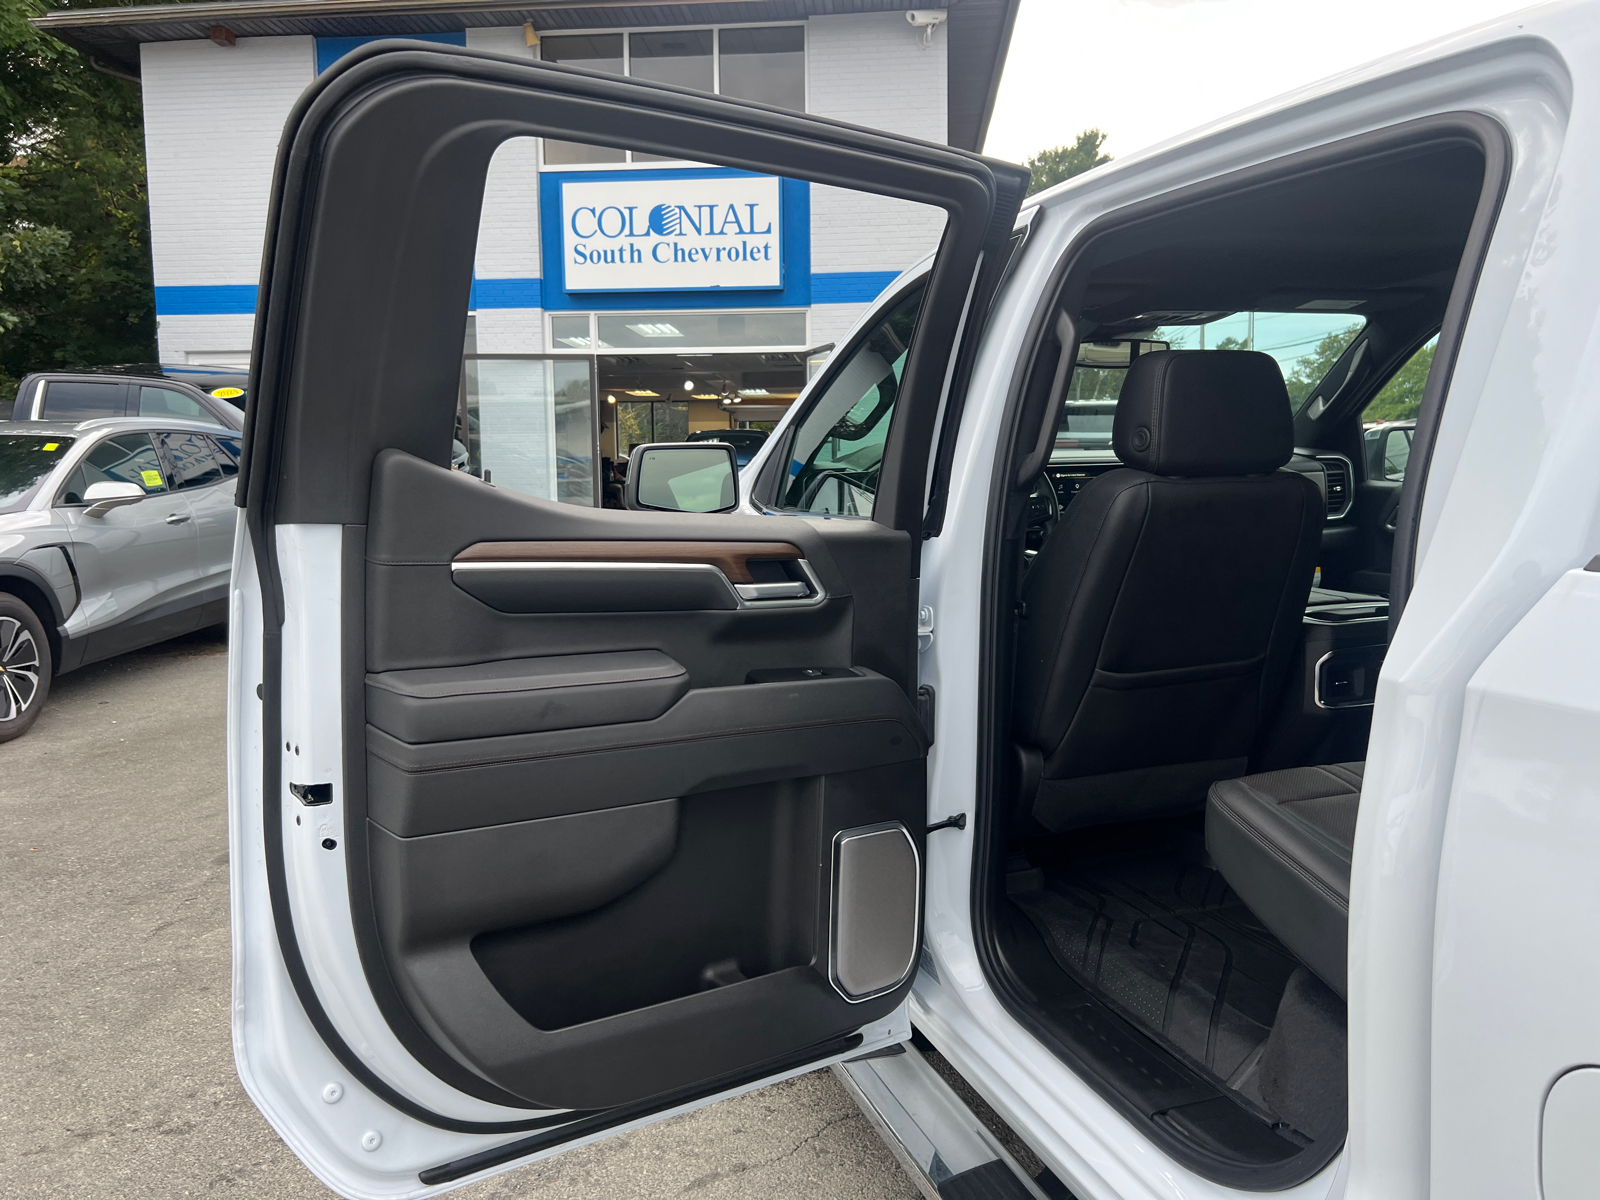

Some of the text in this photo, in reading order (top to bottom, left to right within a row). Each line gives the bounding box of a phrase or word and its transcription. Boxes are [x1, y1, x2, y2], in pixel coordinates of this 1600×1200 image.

[571, 203, 772, 238] COLONIAL
[573, 241, 772, 265] South Chevrolet
